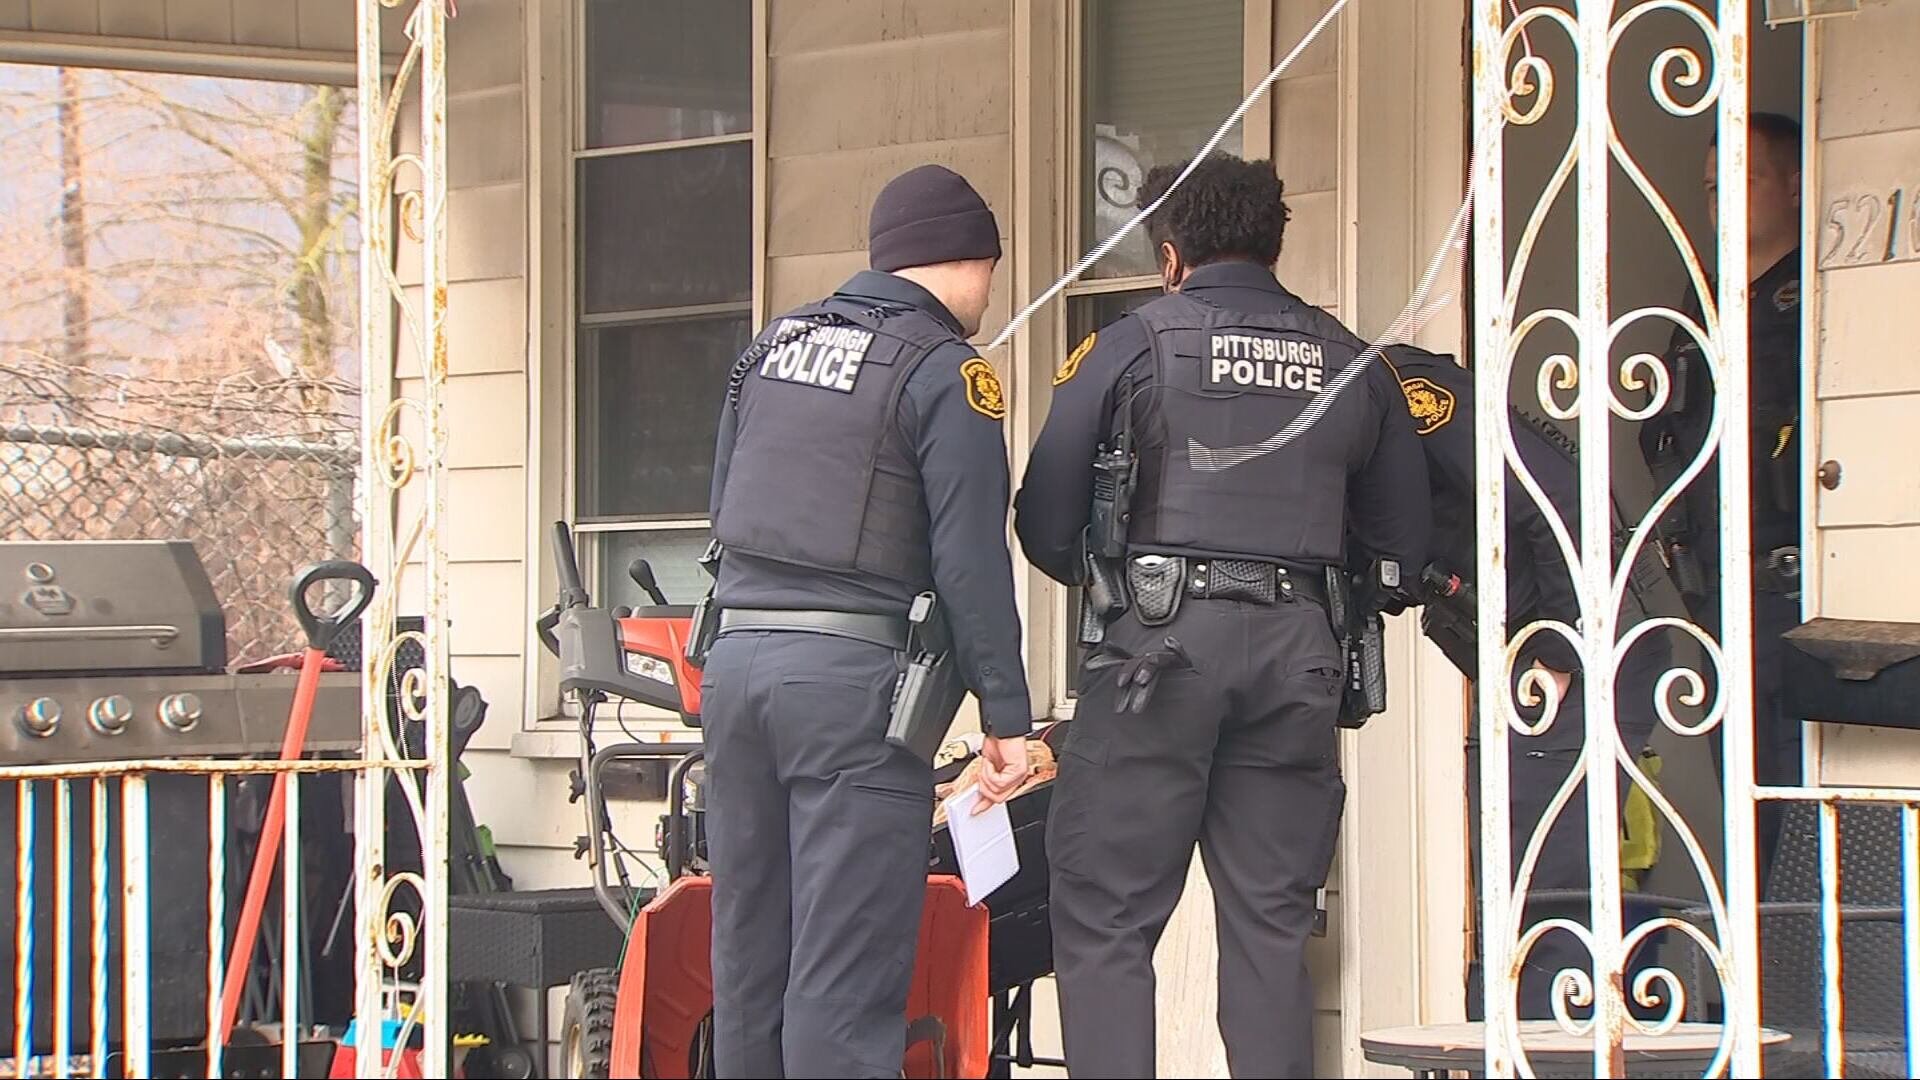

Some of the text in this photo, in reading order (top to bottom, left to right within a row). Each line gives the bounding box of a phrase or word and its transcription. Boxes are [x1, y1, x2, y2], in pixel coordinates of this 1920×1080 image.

[760, 341, 865, 391] POLICE
[1210, 334, 1323, 367] PITTSBURGH
[1210, 358, 1323, 393] POLICE
